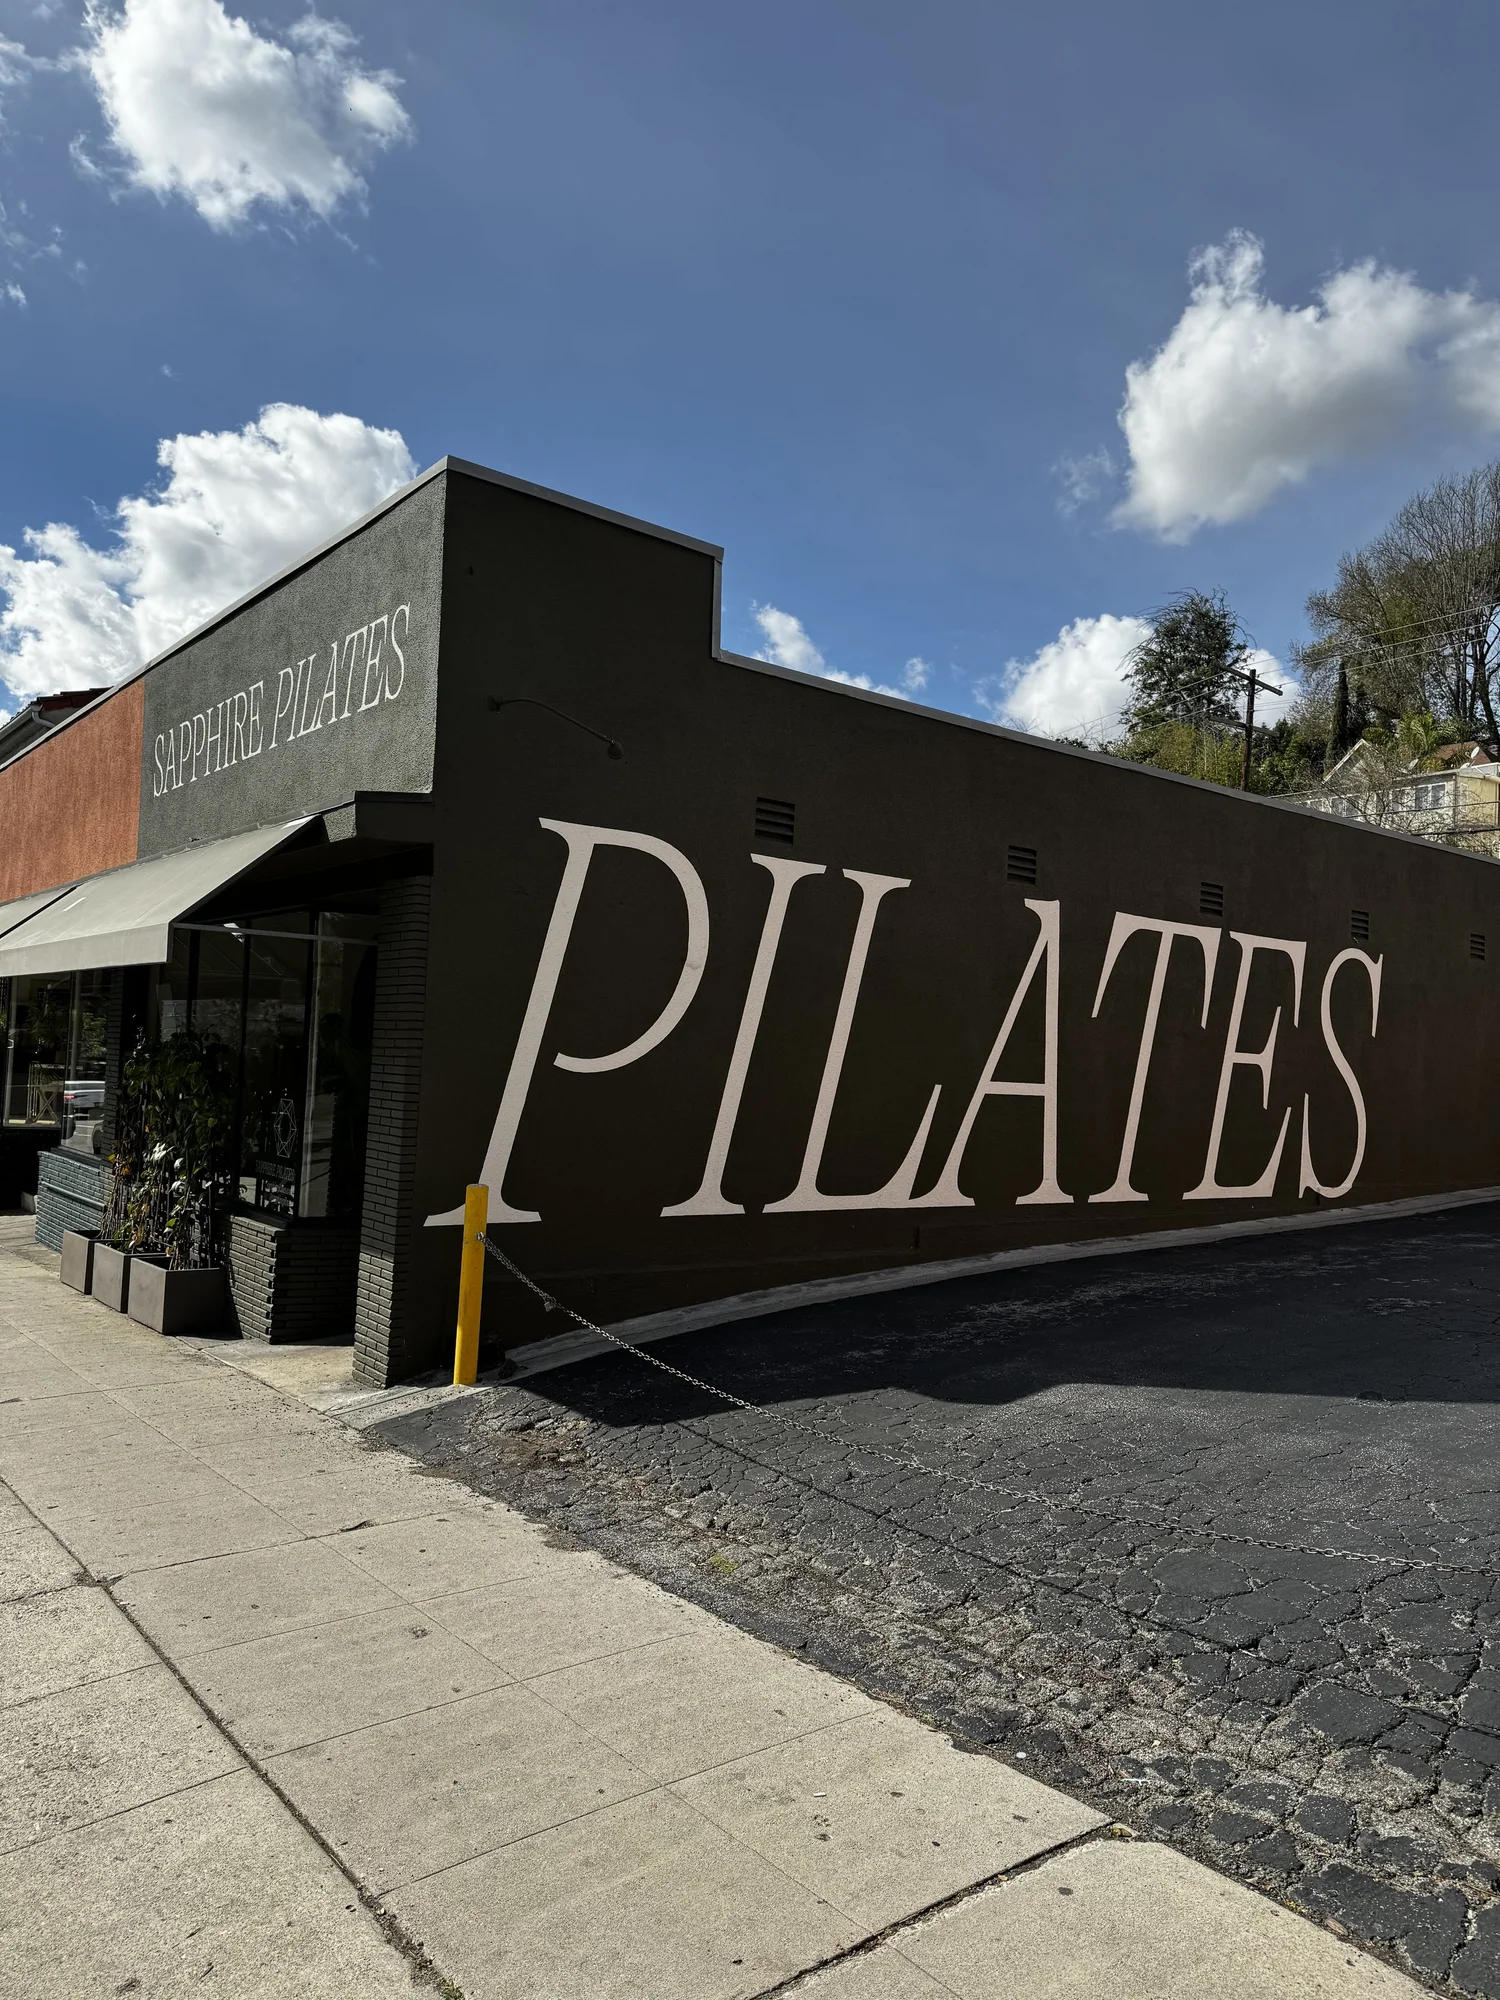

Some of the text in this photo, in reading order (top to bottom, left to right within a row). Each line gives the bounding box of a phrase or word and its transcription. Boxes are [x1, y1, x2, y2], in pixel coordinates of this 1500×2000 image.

[153, 602, 410, 797] SAPPHIRE PILATES
[423, 817, 1383, 1227] PILATES
